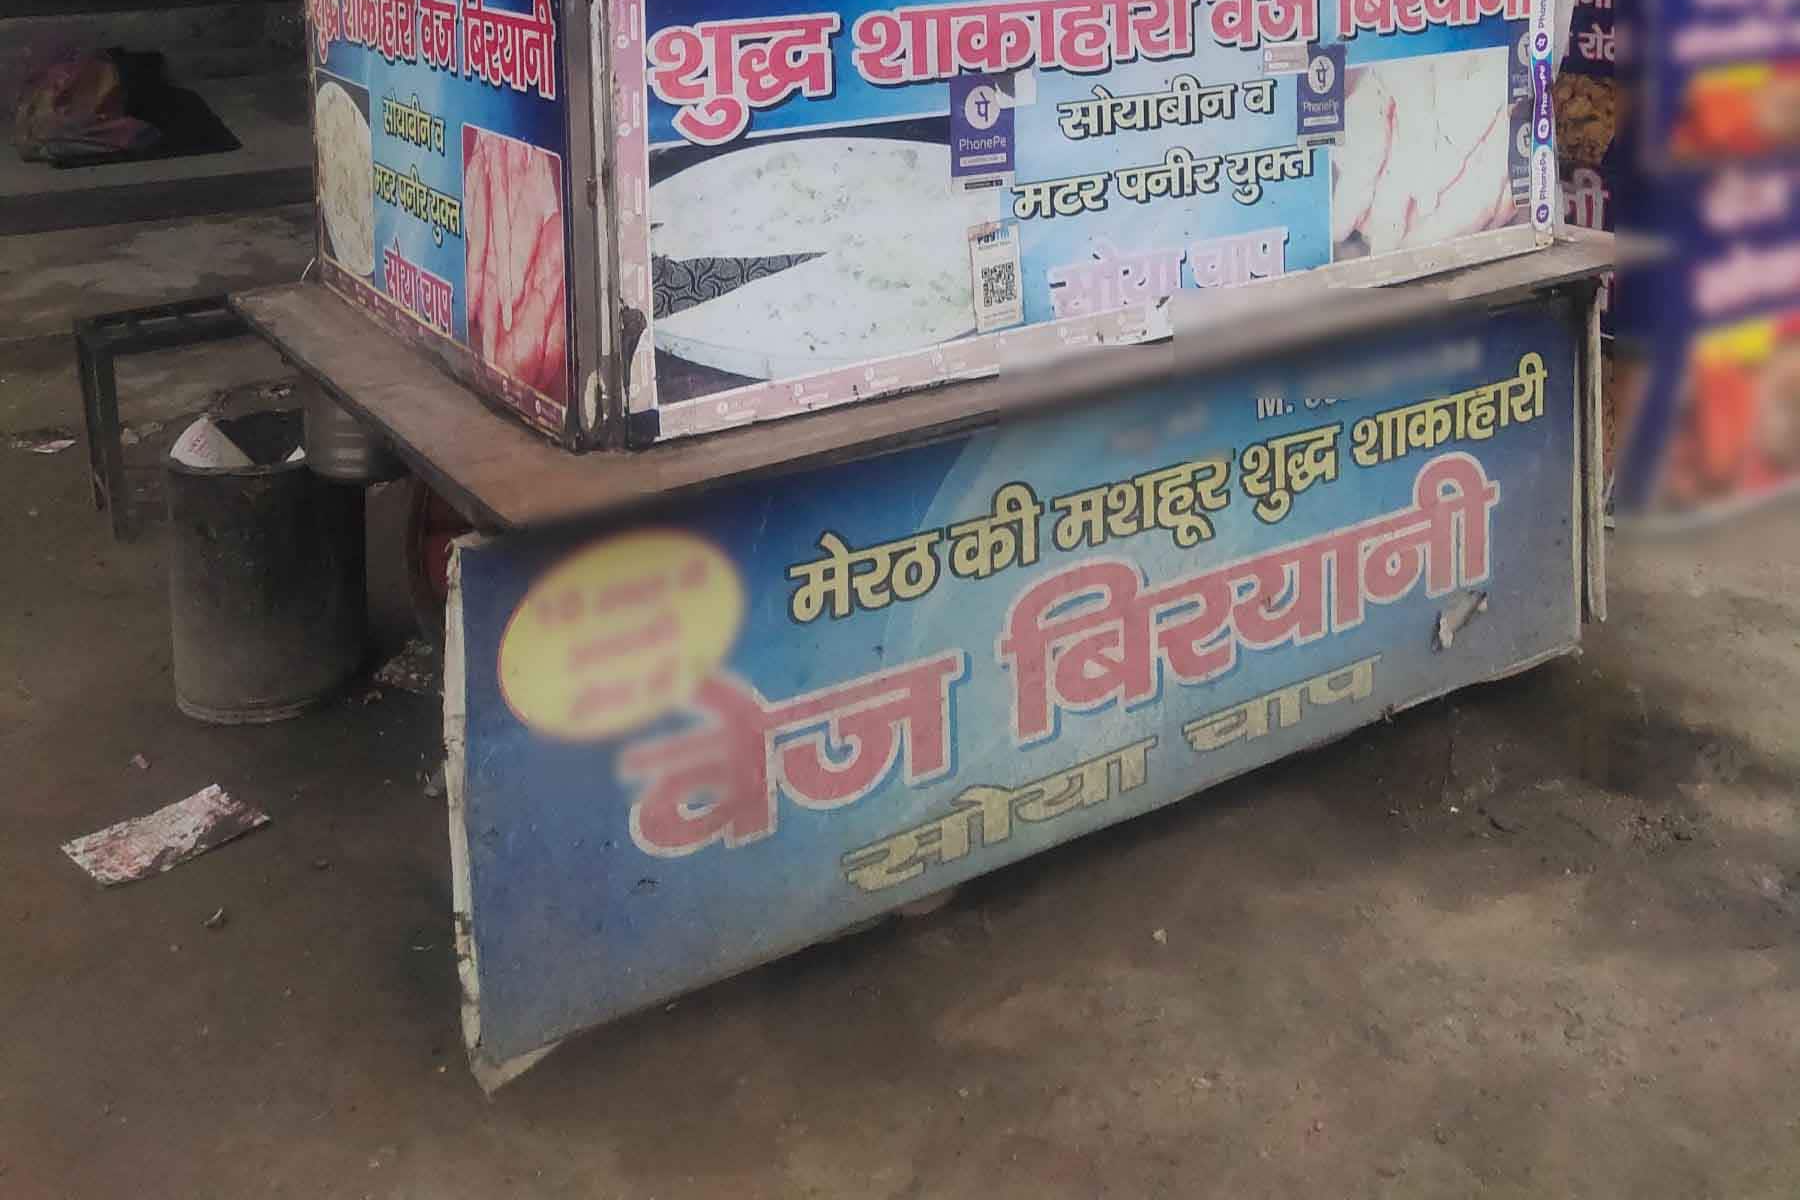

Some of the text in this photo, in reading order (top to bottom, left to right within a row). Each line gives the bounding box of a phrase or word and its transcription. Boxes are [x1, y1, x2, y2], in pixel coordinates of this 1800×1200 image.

[645, 12, 844, 146] शुद्ध
[1056, 74, 1278, 141] सोयाबीन व
[959, 136, 1008, 151] PhonePe
[1010, 142, 1322, 221] मटर पनीर युक्त
[787, 351, 1549, 625] मेरठ की मशहूर शुद्ध शाकाहारी
[620, 648, 974, 858] वेज
[996, 450, 1500, 750] बिरयानी
